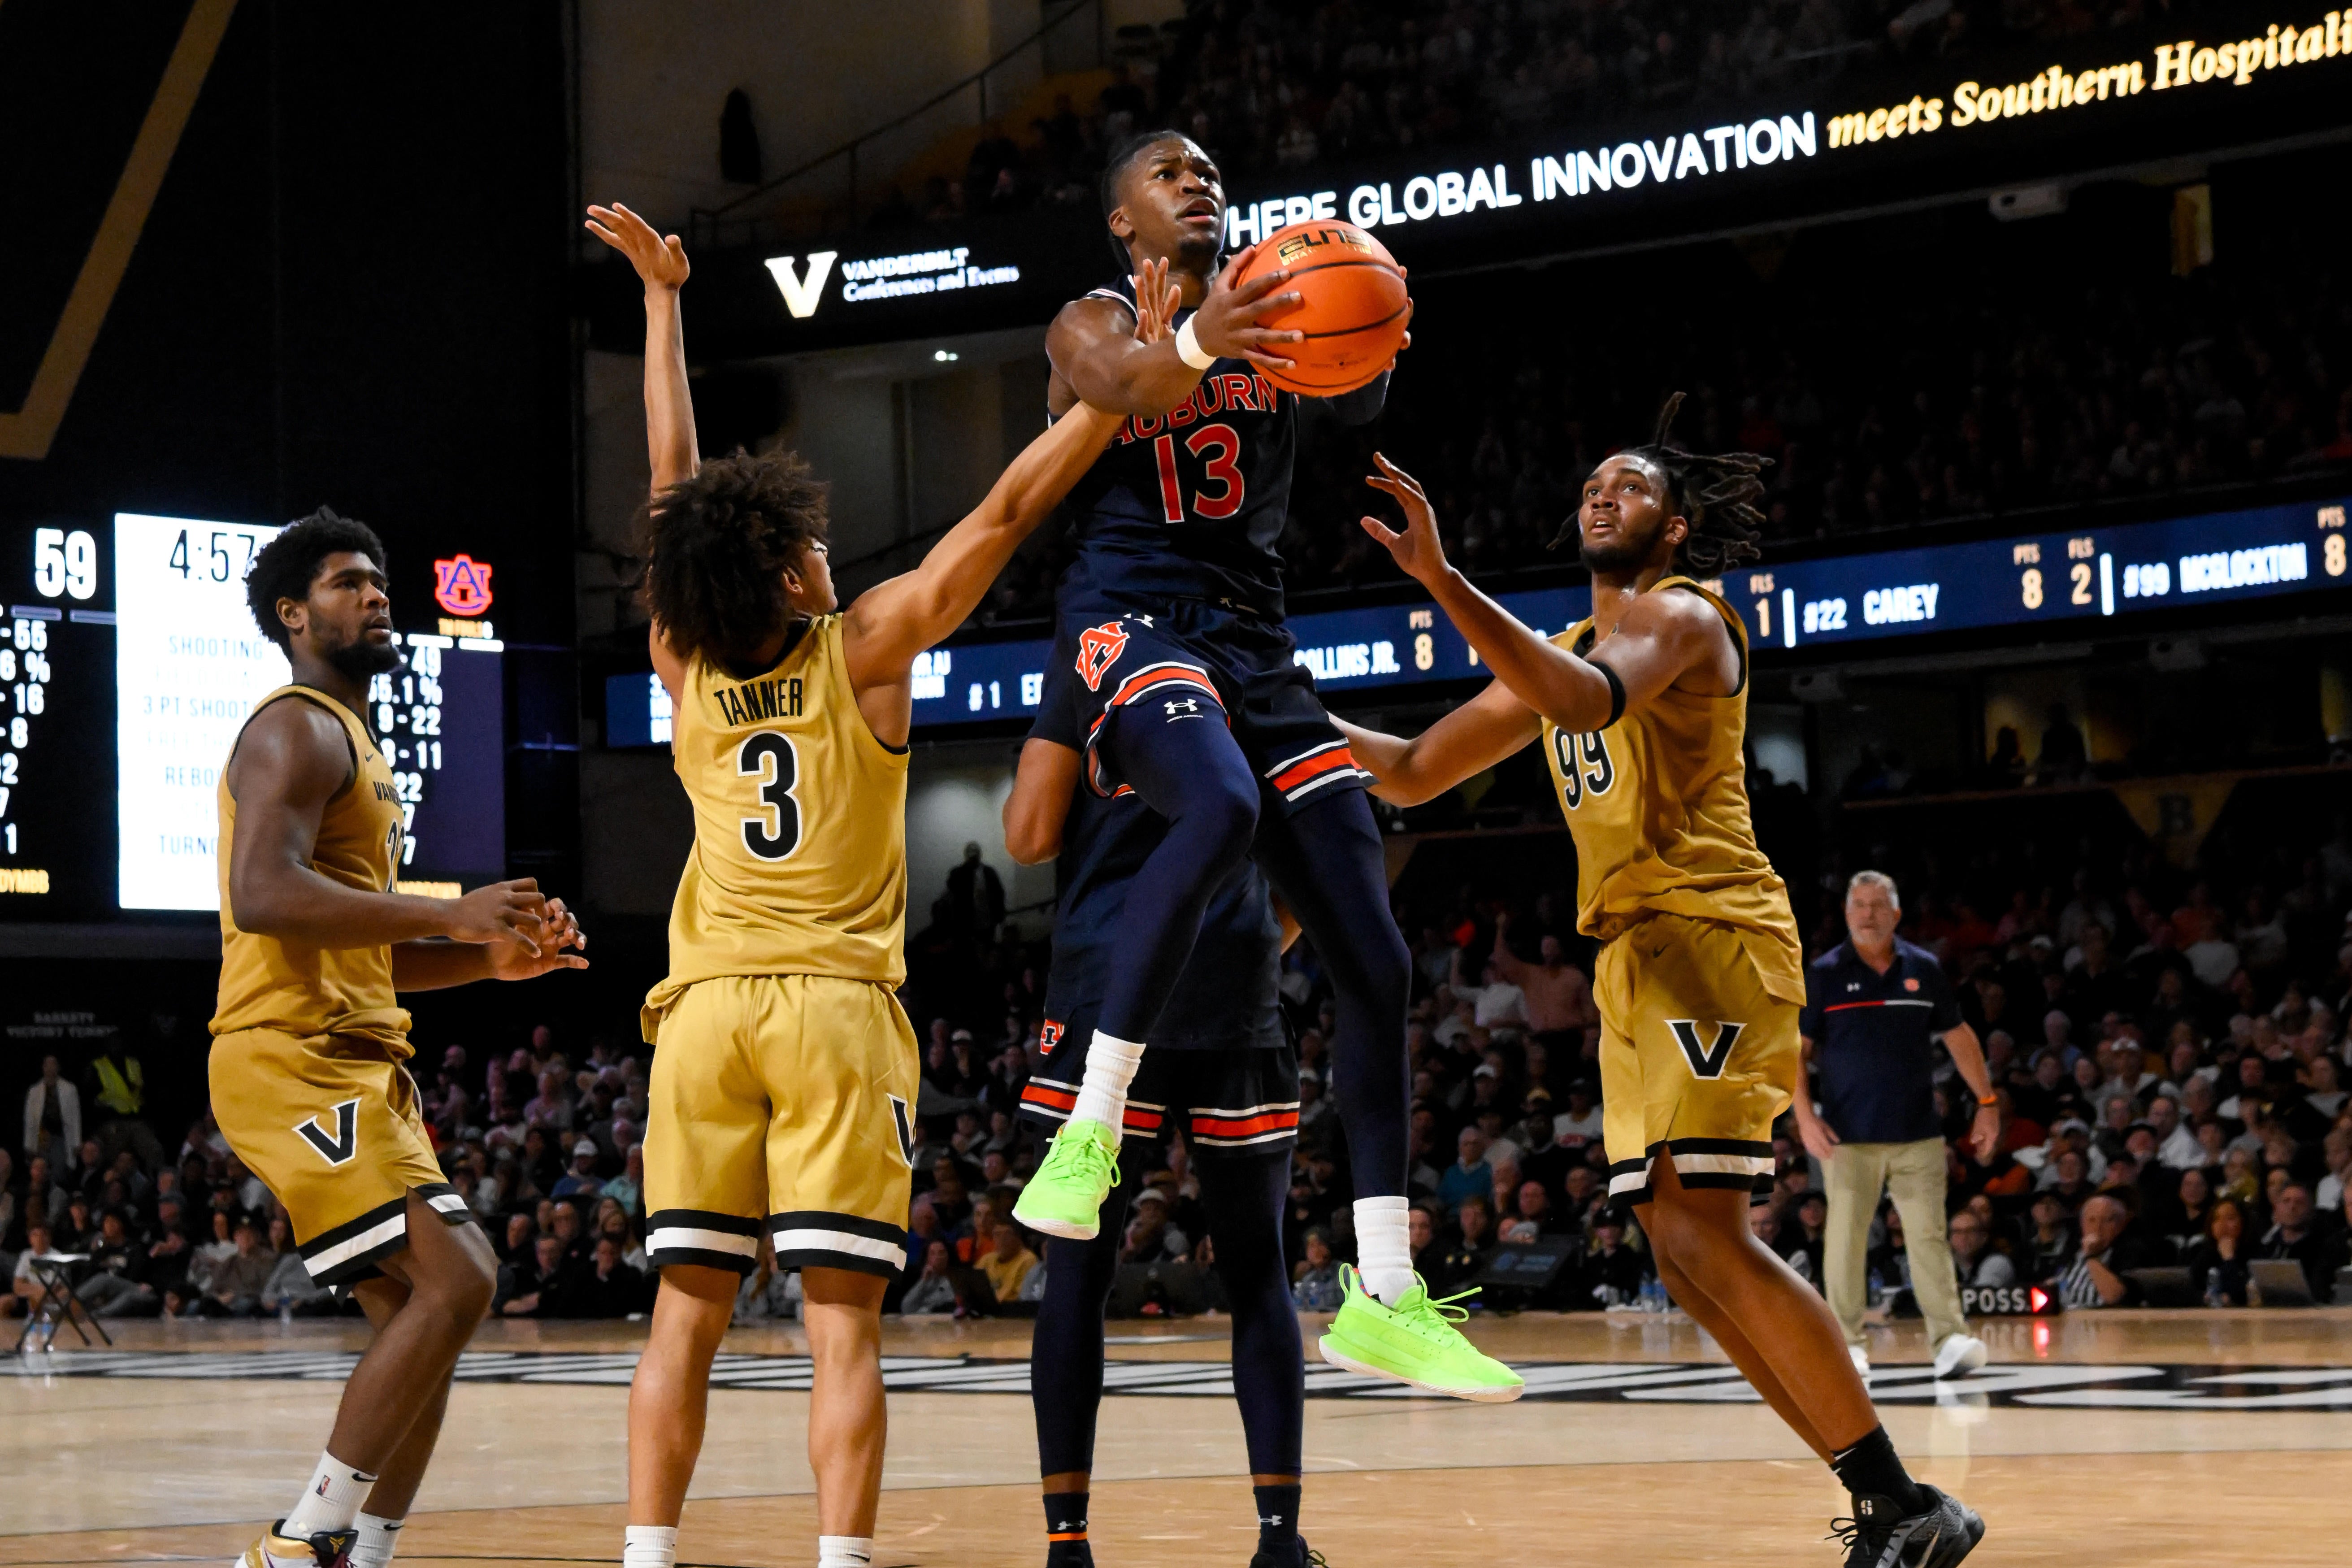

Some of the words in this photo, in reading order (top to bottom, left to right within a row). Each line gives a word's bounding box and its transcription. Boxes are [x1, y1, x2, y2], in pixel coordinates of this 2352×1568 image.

[1220, 191, 1337, 252] HERE
[1348, 164, 1522, 228] GLOBAL
[1532, 111, 1817, 202] INNOVATION
[1827, 95, 1944, 148] meets
[1951, 61, 2146, 127] Southern
[2152, 8, 2352, 91] Hospitali
[764, 251, 838, 318] V
[842, 248, 969, 281] VANDERBILT
[843, 277, 935, 302] Conferences
[936, 267, 966, 291] and
[966, 266, 1020, 287] Events
[1154, 423, 1245, 524] 13
[35, 527, 96, 599] 59
[169, 529, 255, 582] 4:57
[2324, 534, 2347, 577] 8
[1803, 597, 1847, 634] #22
[1863, 583, 1940, 625] CAREY
[2022, 568, 2043, 609] 8
[2070, 563, 2092, 605] 2
[1755, 598, 1770, 637] 1
[169, 635, 263, 660] SHOOTING
[411, 645, 441, 678] 49
[1370, 640, 1401, 675] JR.
[1415, 633, 1433, 671] 8
[14, 682, 44, 715] 16
[143, 695, 152, 715] 3
[160, 696, 180, 716] PT
[190, 698, 256, 720] SHOOT
[714, 678, 803, 727] TANNER
[1553, 725, 1614, 811] 99
[737, 729, 803, 863] 3
[1664, 1019, 1748, 1080] V
[292, 1097, 362, 1167] V
